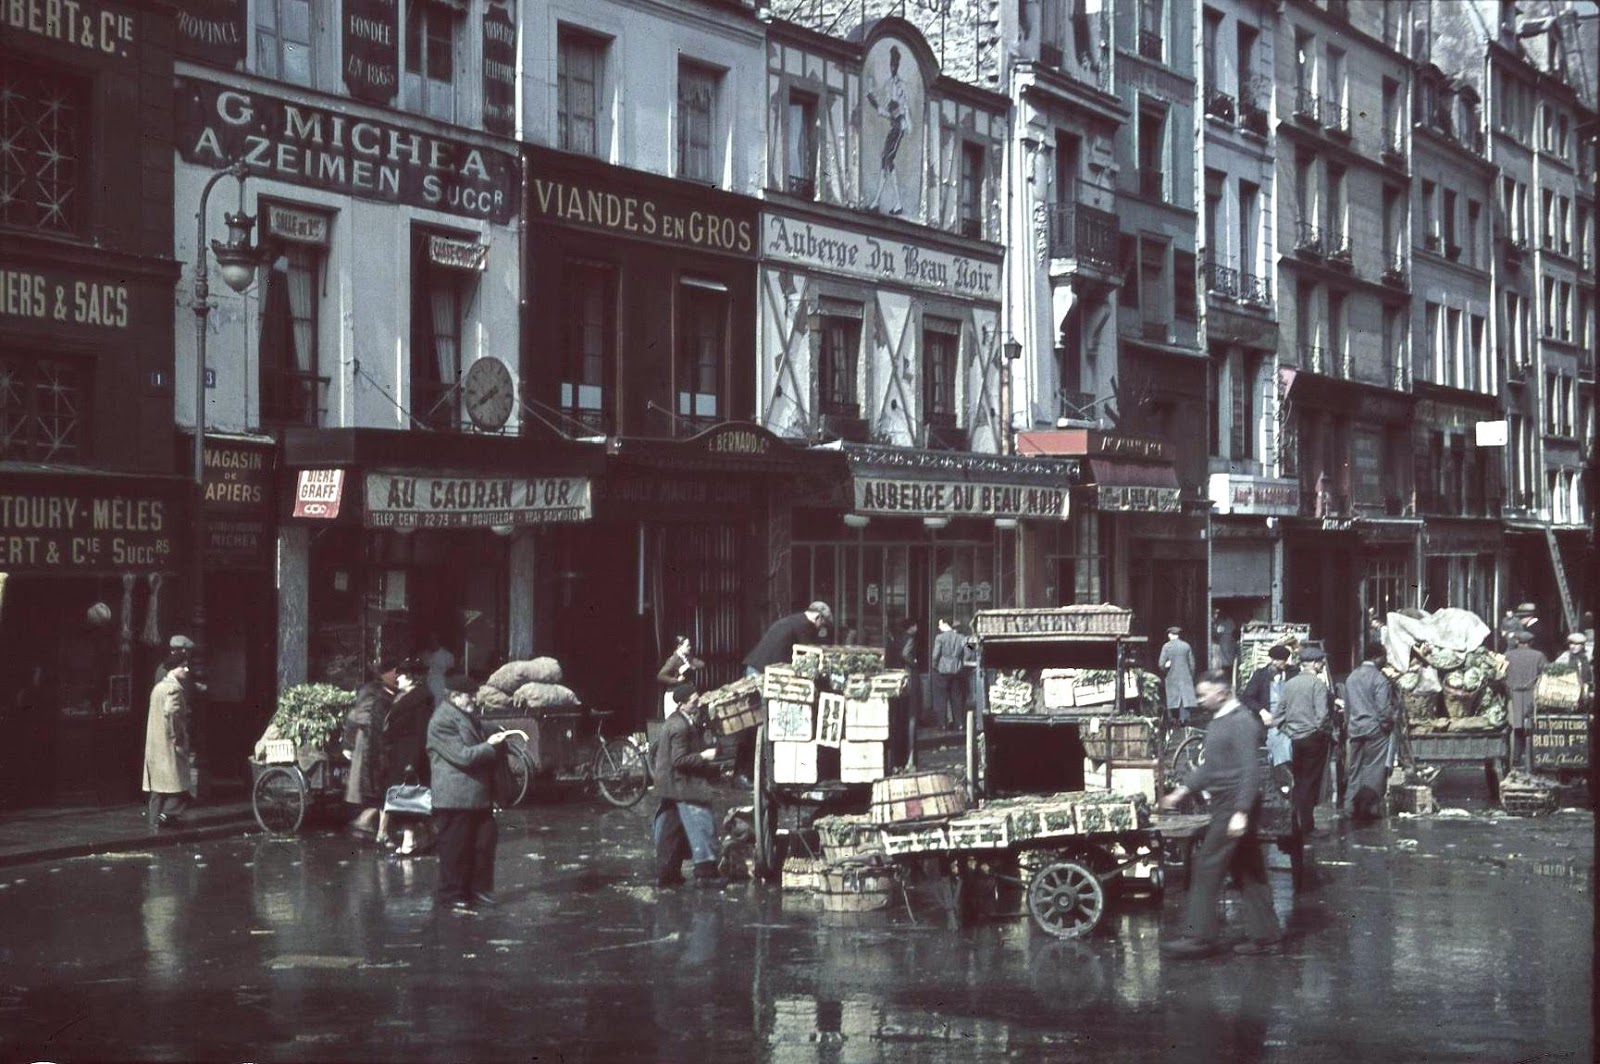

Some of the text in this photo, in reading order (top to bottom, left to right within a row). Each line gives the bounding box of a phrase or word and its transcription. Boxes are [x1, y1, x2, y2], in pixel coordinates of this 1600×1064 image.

[0, 0, 79, 42] BERT
[244, 135, 400, 196] ZEIMEN
[535, 179, 751, 251] VIANDES EN GROS
[770, 216, 859, 267] Auberge
[902, 244, 949, 285] Beau
[953, 256, 993, 292] Noir
[54, 284, 67, 320] &
[75, 281, 128, 327] SACS
[204, 449, 262, 469] MAGASIN
[204, 483, 262, 501] APIERS
[301, 484, 336, 499] GRAFF
[387, 479, 416, 508] AU
[525, 479, 571, 507] D'OR
[864, 482, 945, 511] AUBERGE
[953, 483, 976, 511] DU
[982, 484, 1022, 513] BEAU
[46, 541, 60, 564] &
